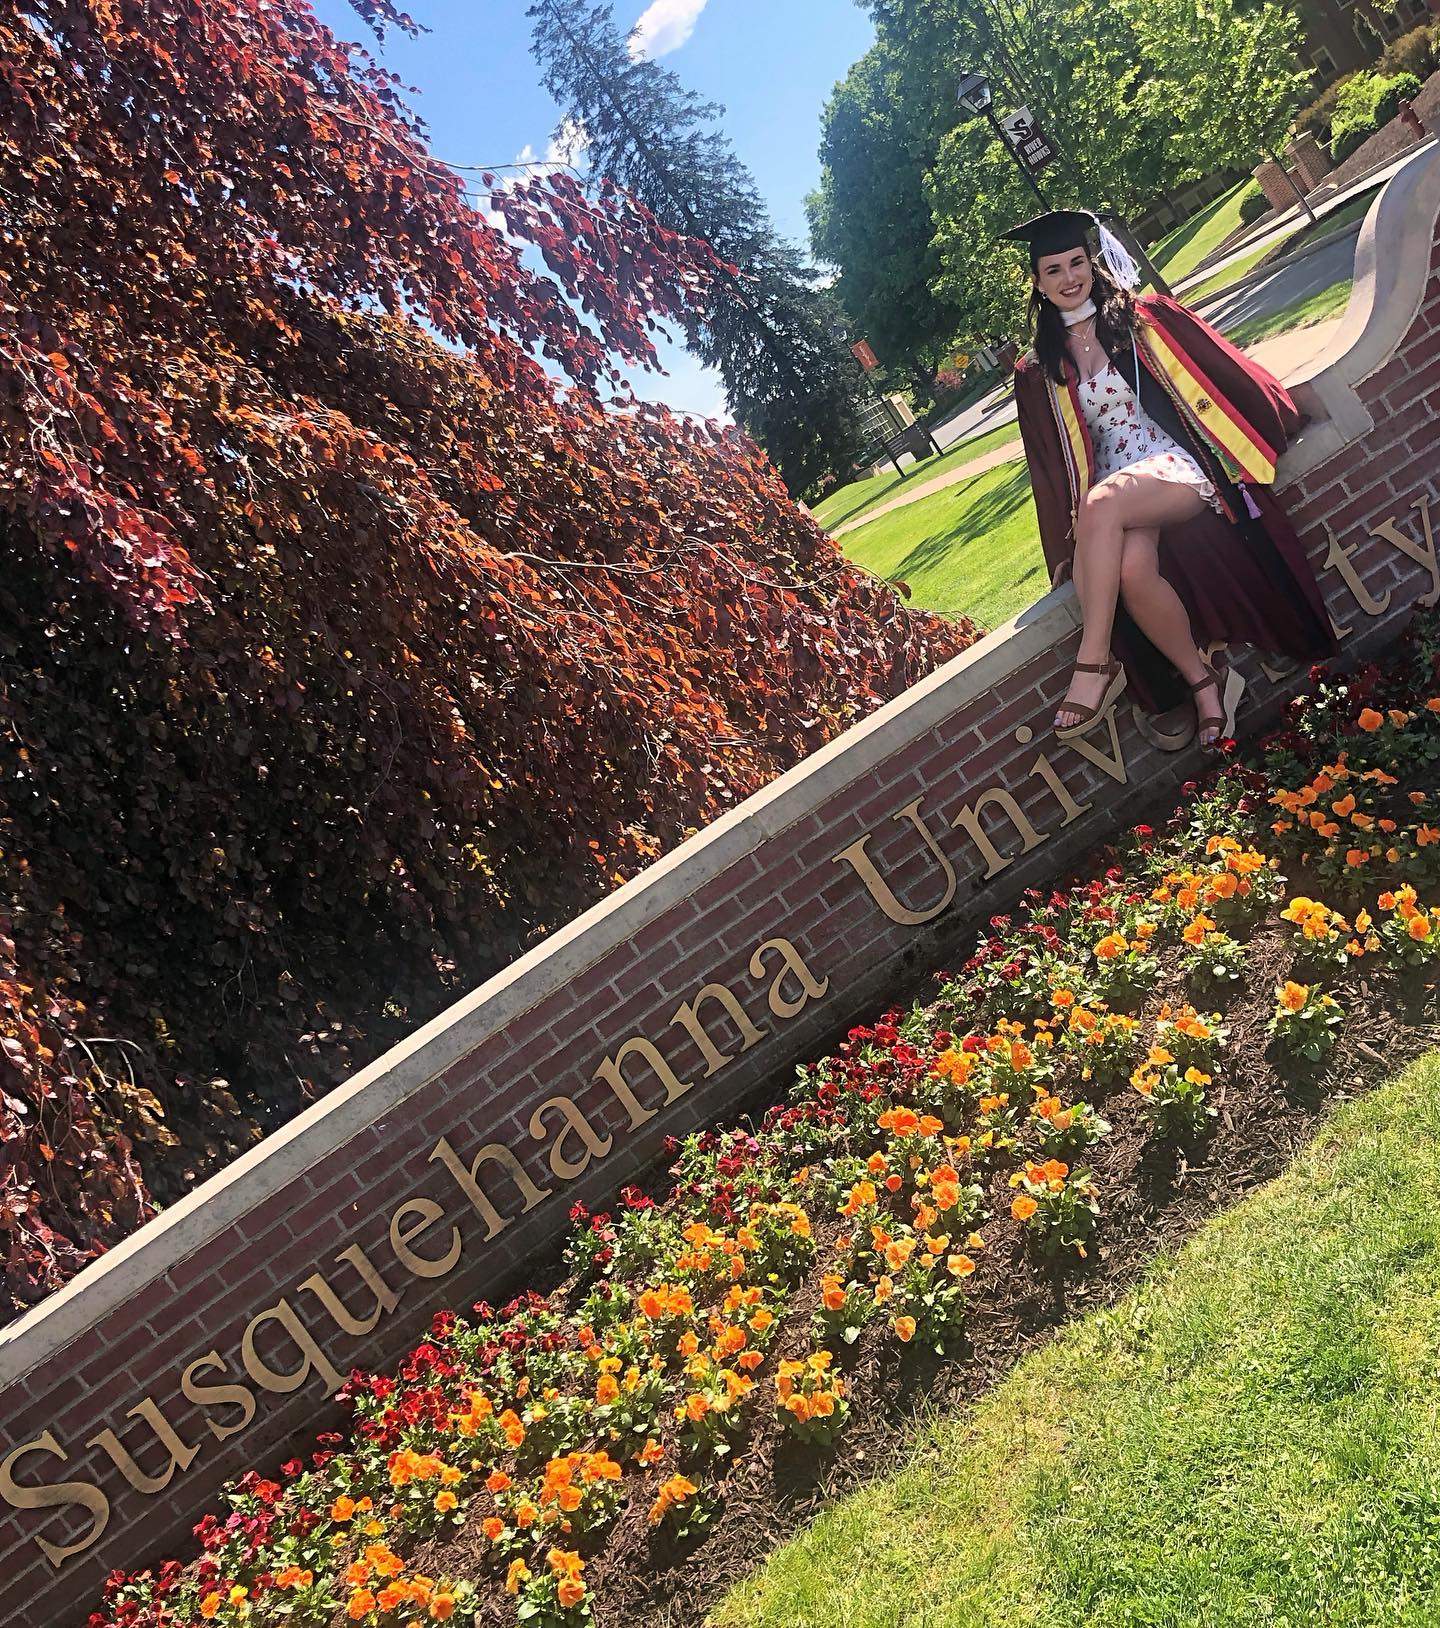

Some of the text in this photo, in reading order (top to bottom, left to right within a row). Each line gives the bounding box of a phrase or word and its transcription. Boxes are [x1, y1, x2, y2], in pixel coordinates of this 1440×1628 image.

[1023, 137, 1043, 156] RIVER
[1027, 144, 1052, 166] HAWKS
[0, 937, 829, 1568] Susquehanna
